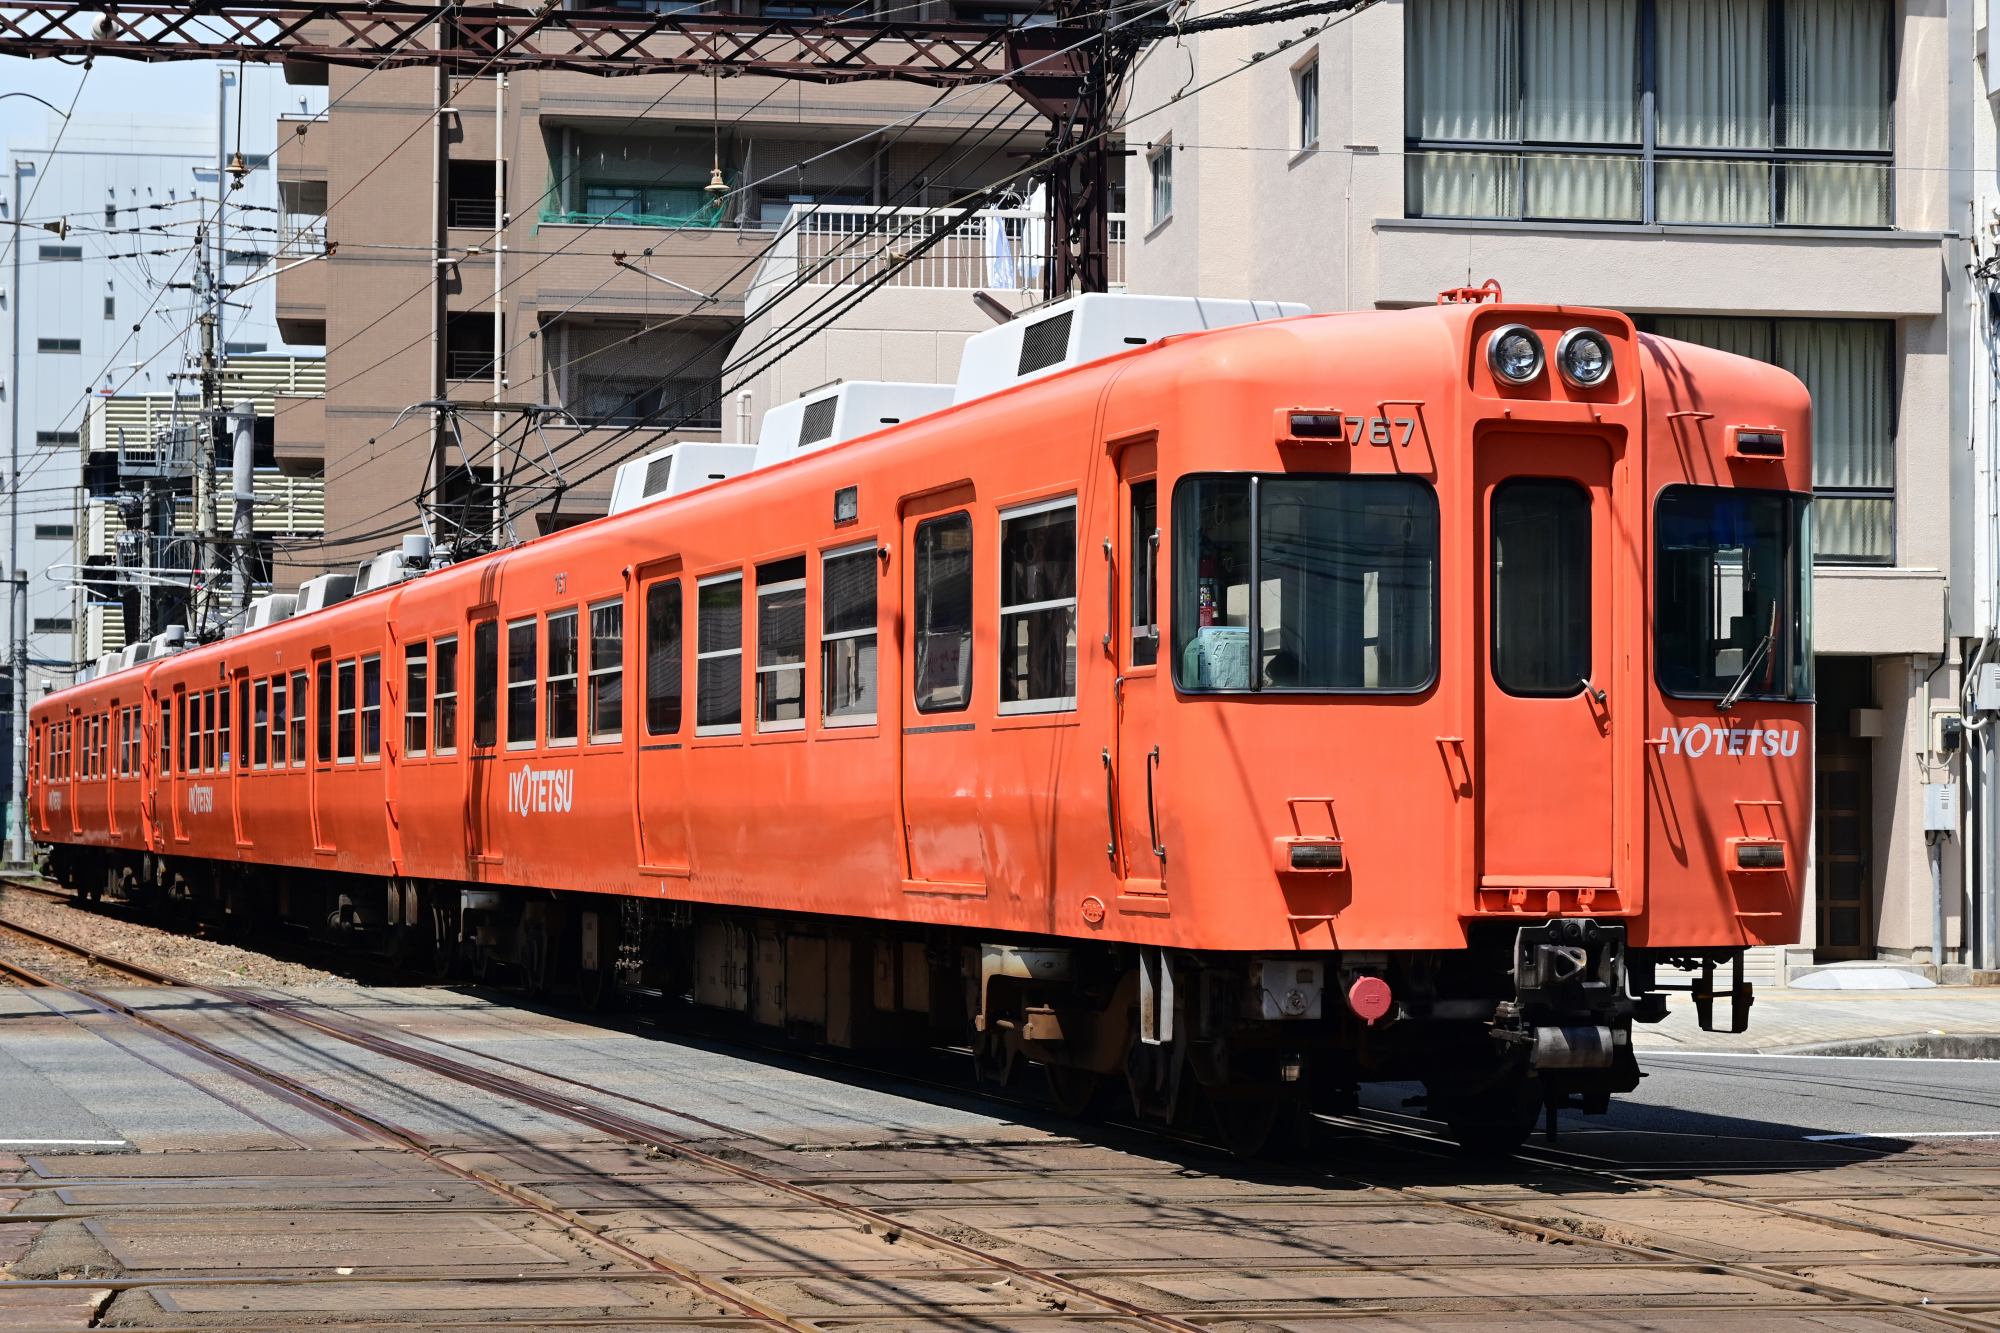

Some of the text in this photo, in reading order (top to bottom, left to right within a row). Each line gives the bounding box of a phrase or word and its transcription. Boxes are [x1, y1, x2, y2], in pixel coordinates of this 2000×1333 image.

[1344, 416, 1415, 446] 767
[1658, 722, 1800, 758] IYOTETSU
[508, 763, 574, 817] IYOTETSU
